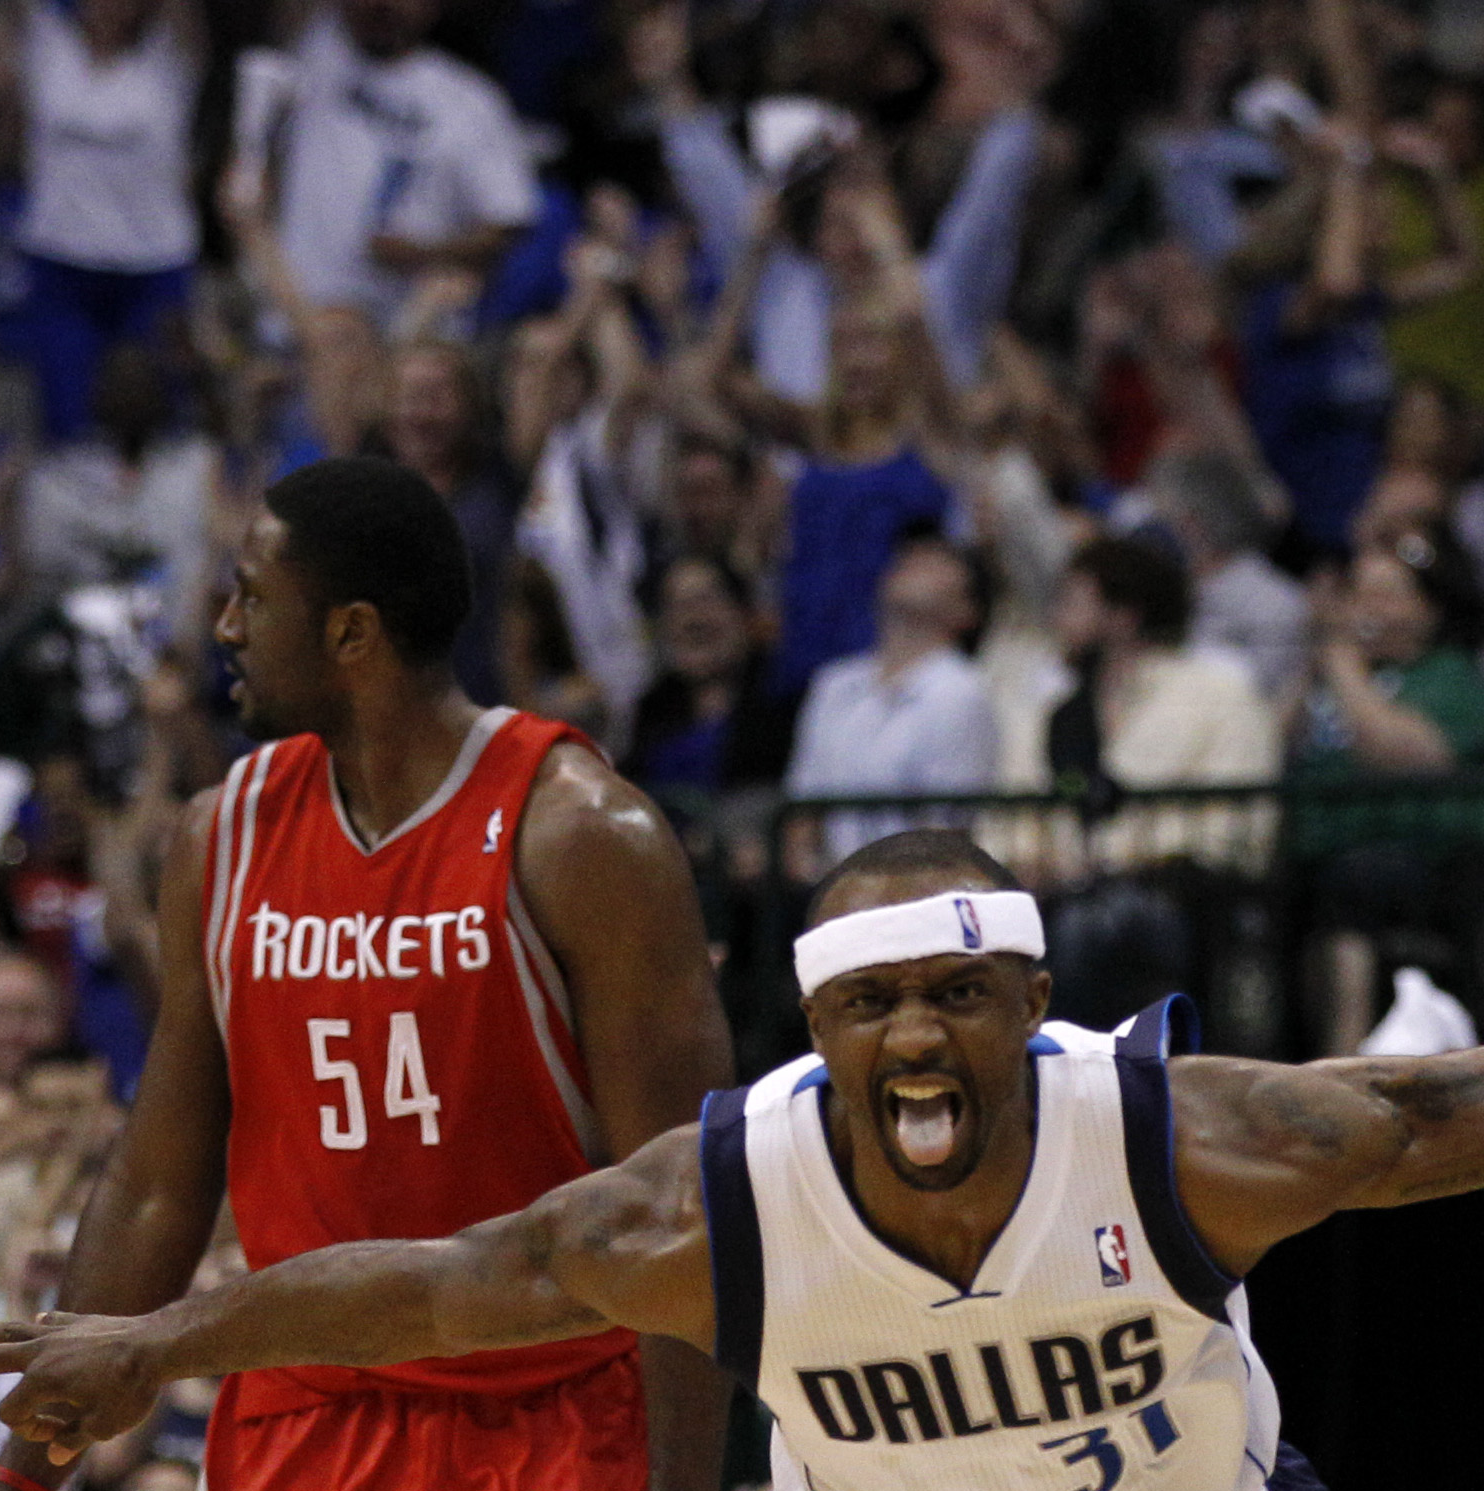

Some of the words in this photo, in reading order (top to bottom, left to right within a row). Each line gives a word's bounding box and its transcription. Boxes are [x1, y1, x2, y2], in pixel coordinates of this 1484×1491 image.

[247, 901, 491, 982] ROCKETS
[306, 1011, 441, 1150] 54
[795, 1311, 1167, 1445] DALLAS
